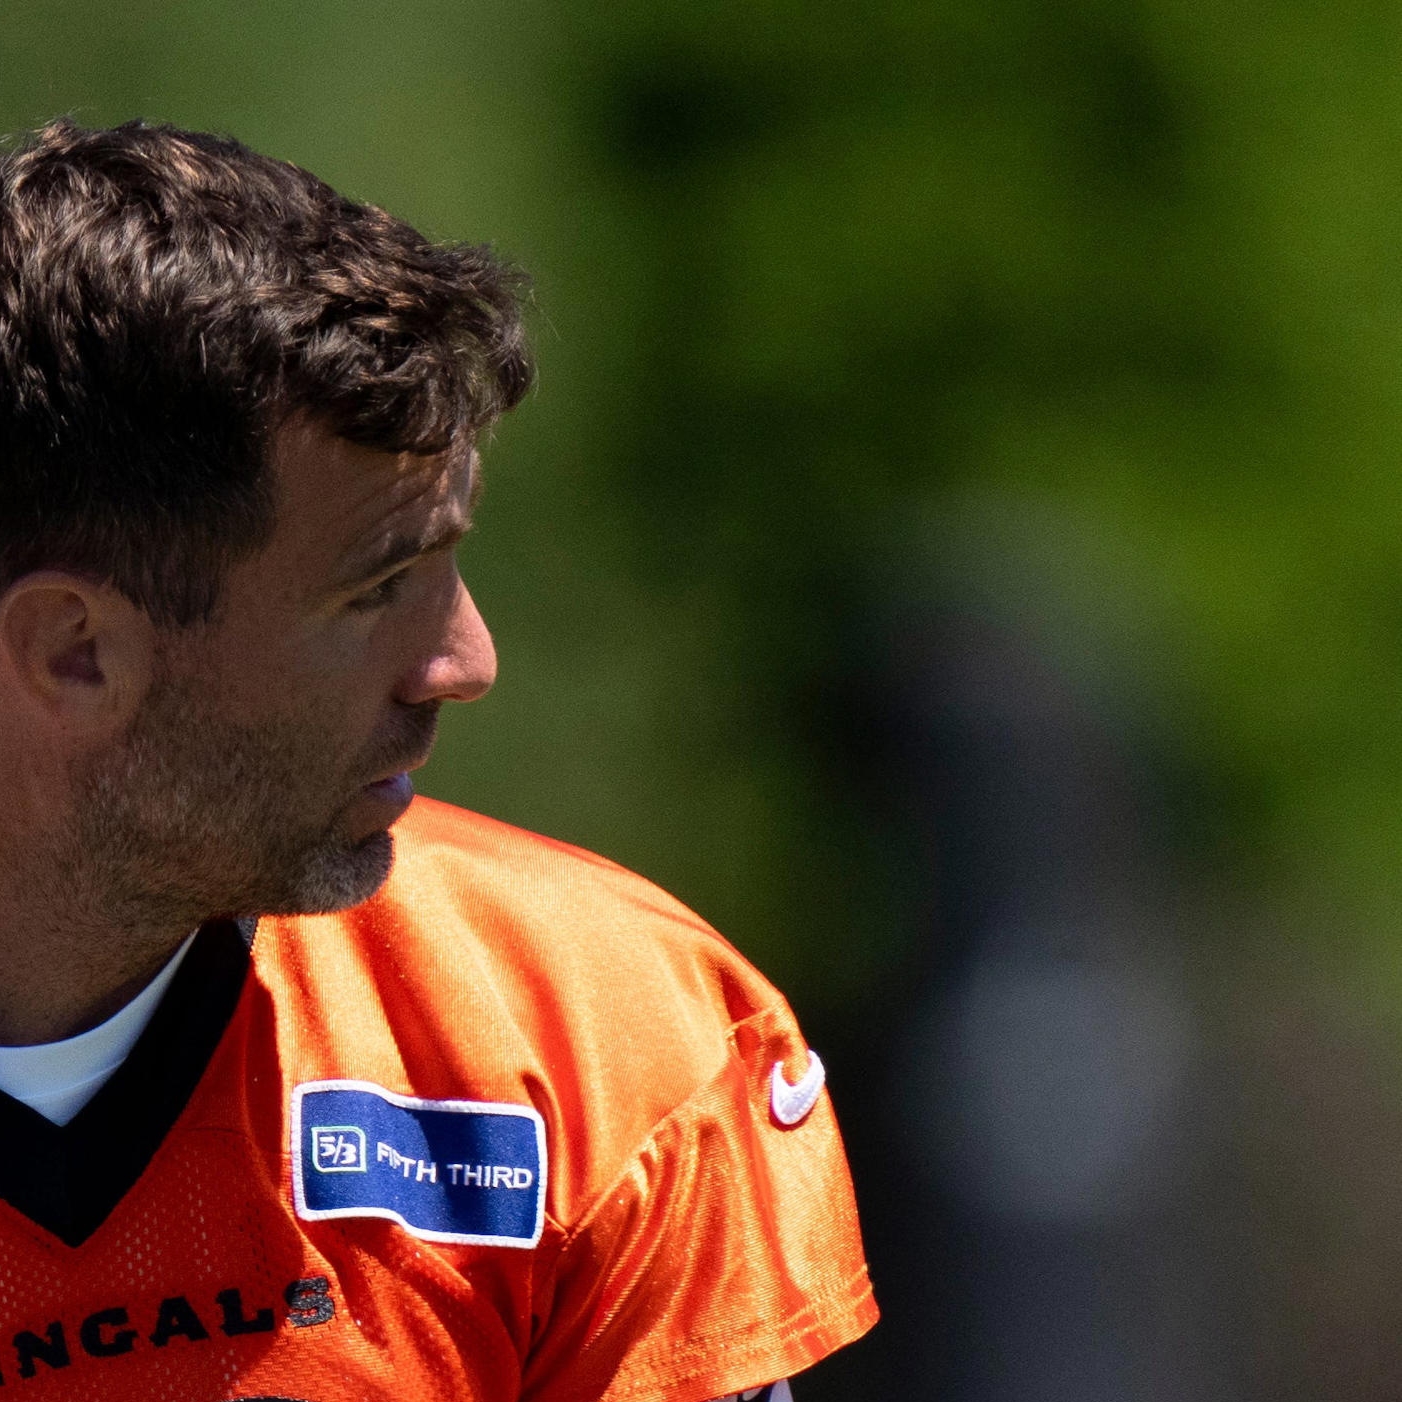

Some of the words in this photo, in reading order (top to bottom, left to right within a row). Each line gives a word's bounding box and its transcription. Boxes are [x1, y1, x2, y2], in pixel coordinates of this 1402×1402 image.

[318, 1135, 358, 1165] 5/3
[376, 1141, 437, 1184] FIFTH
[446, 1163, 534, 1190] THIRD
